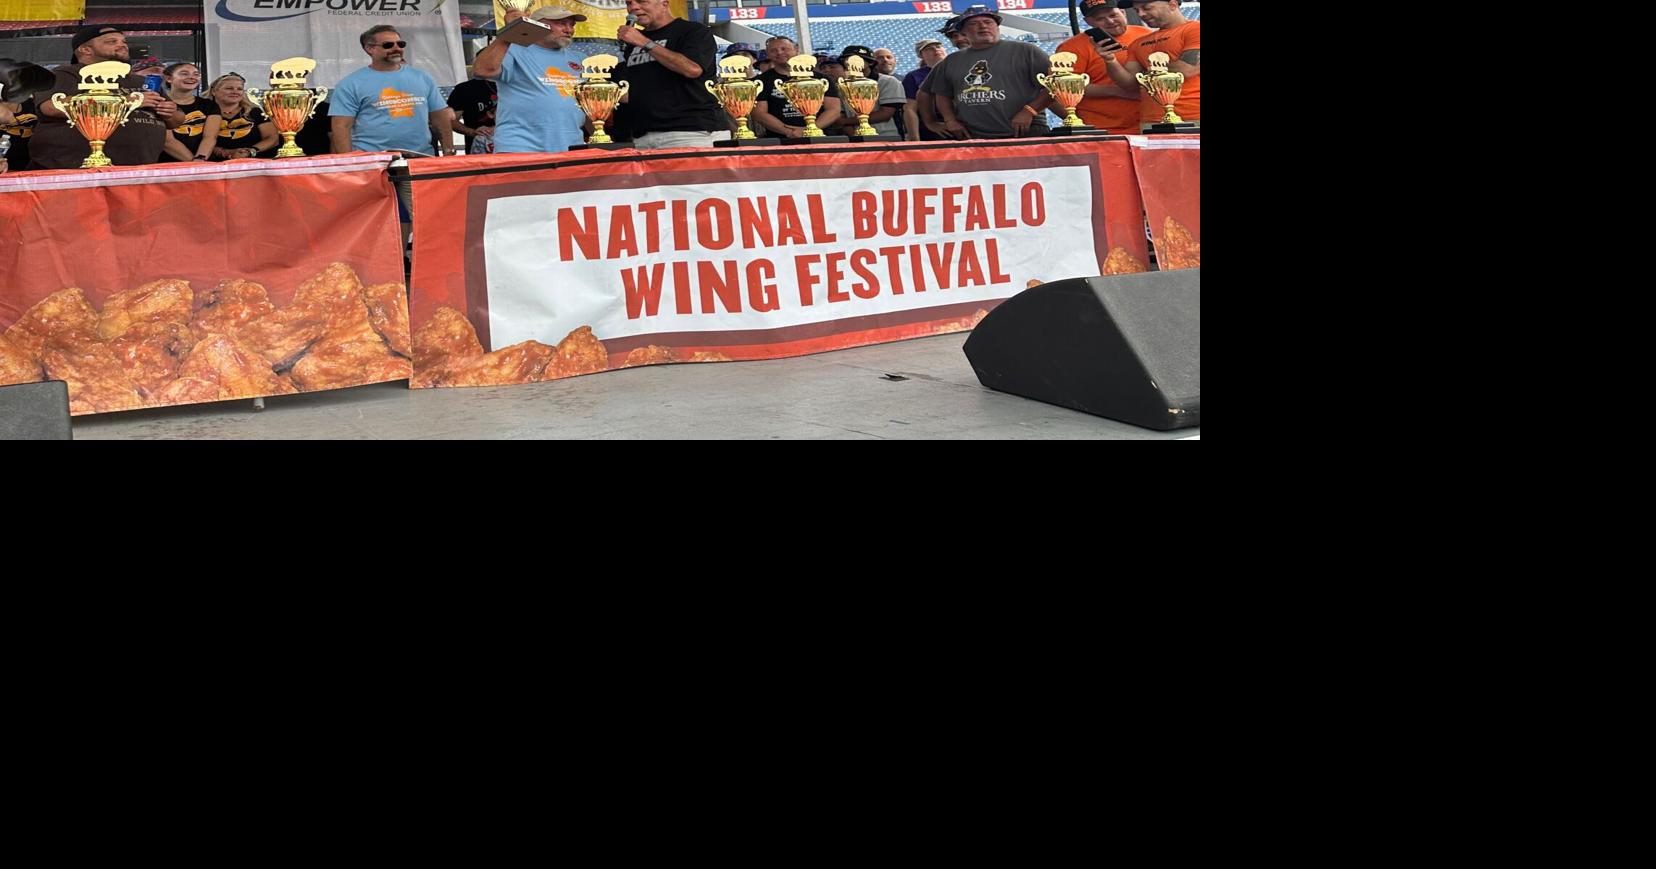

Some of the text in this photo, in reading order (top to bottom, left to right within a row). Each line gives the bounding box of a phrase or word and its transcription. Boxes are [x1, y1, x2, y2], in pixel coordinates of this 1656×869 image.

[923, 2, 952, 12] 133
[999, 0, 1027, 9] 134
[730, 8, 759, 19] 133
[557, 182, 1046, 262] NATIONAL BUFFALO
[621, 238, 1010, 320] WING FESTIVAL
